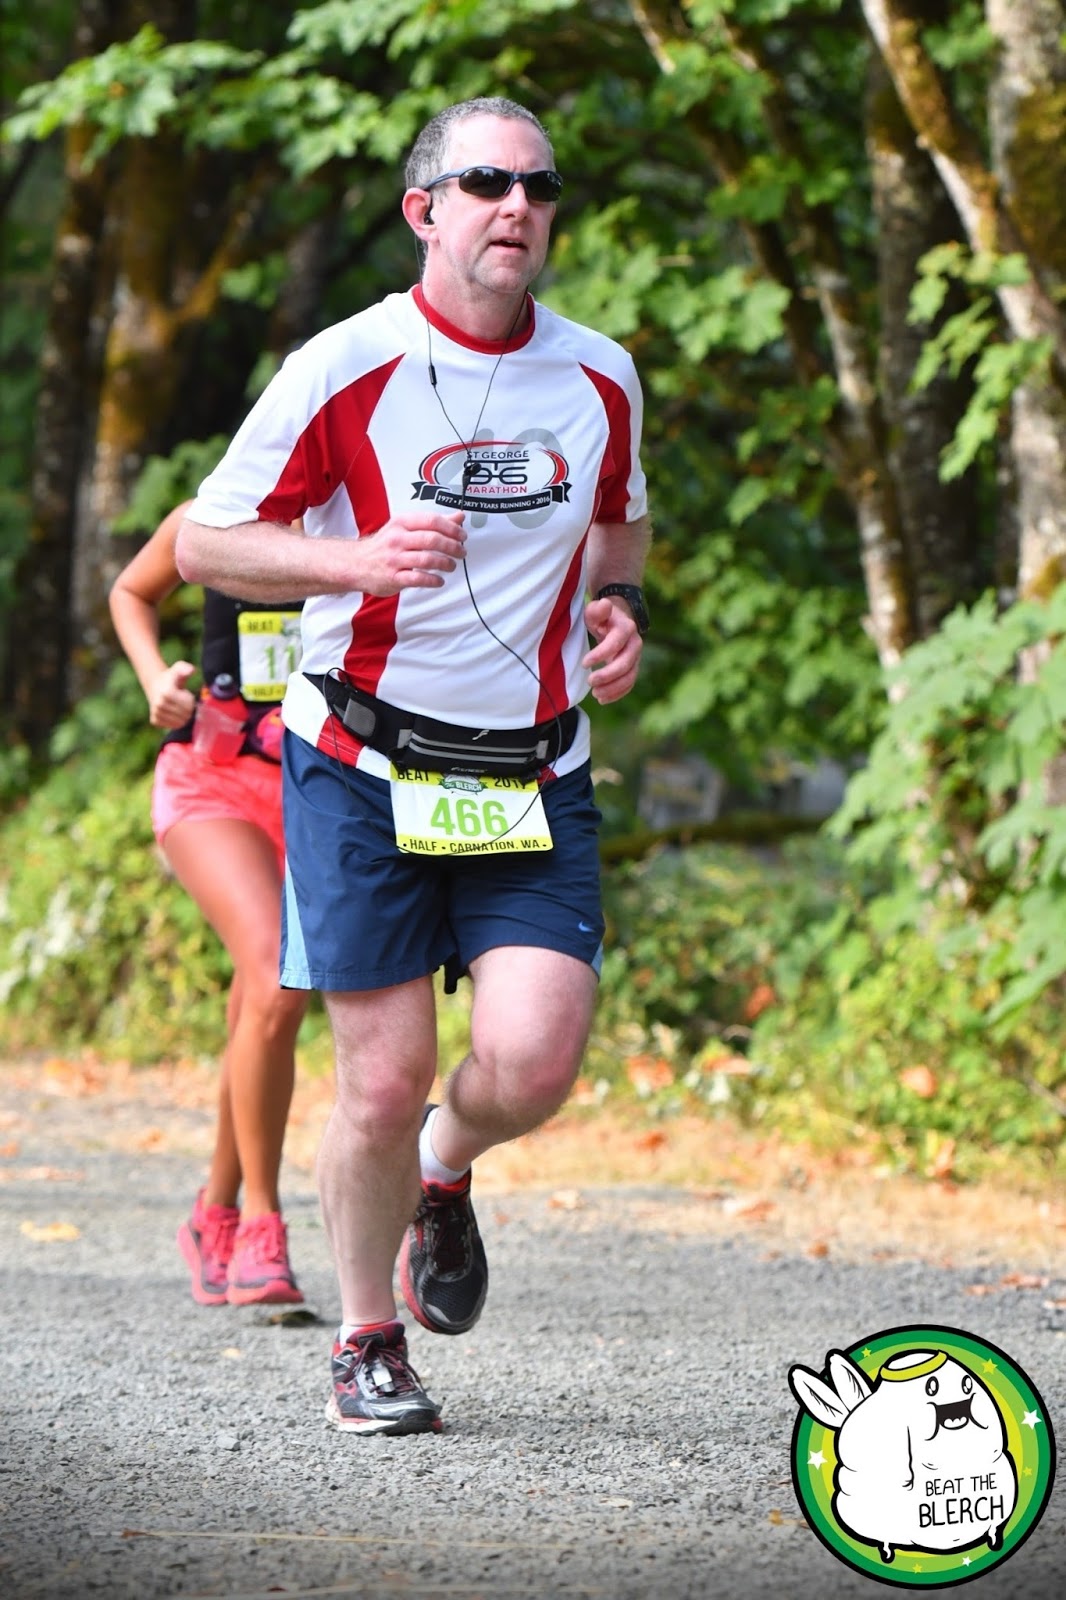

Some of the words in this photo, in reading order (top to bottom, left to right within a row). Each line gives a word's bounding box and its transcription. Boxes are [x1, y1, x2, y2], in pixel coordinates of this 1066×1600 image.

[482, 450, 529, 459] GEORGE
[466, 486, 527, 494] MARATHON
[438, 494, 453, 504] 1977
[500, 501, 531, 509] RUNNING
[536, 496, 550, 505] 2016
[456, 781, 482, 791] BLERCH
[430, 797, 509, 837] 466
[409, 839, 437, 852] HALF
[522, 839, 540, 849] WA
